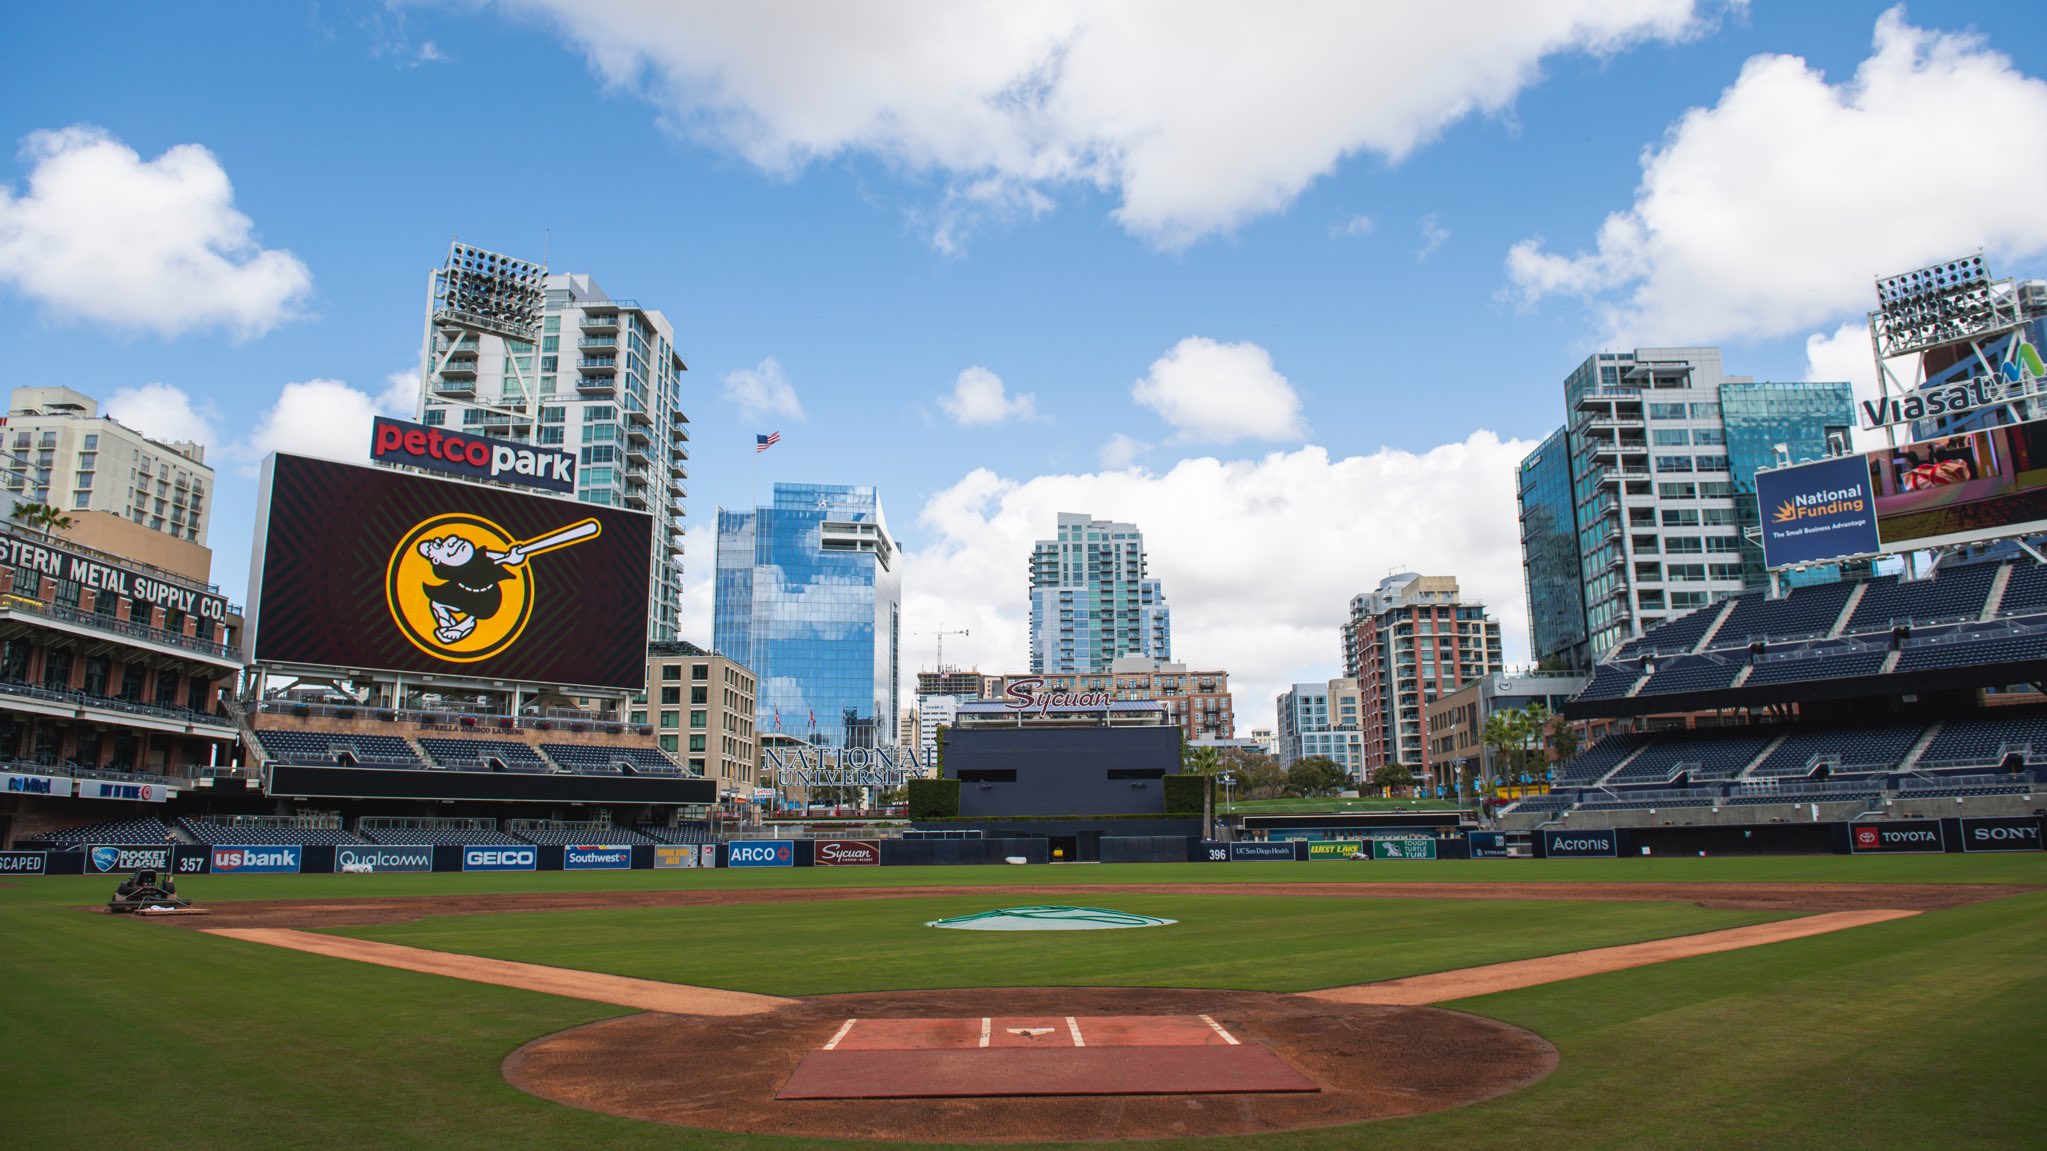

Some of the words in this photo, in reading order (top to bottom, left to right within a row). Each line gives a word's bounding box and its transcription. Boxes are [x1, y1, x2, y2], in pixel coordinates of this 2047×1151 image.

[1863, 376, 1991, 427] Viasat
[1795, 484, 1862, 507] National
[1797, 499, 1864, 519] Funding
[1786, 528, 1803, 536] Small
[1804, 525, 1831, 534] Business
[1832, 520, 1866, 530] Advantage
[70, 558, 129, 596] METAL
[134, 577, 197, 613] SUPPLY
[201, 597, 225, 622] CO.
[1004, 677, 1114, 718] Sycuan
[492, 727, 524, 735] LANDING
[762, 746, 937, 770] NATIONAL
[777, 769, 925, 786] UNIVERSITY
[23, 778, 51, 794] Mitel
[1882, 831, 1936, 842] TOYOTA
[1974, 827, 2038, 840] SONY
[1336, 845, 1359, 853] LAKE
[1553, 837, 1609, 850] Acronis
[120, 850, 166, 859] ROCKET
[466, 851, 534, 865] GEICO
[569, 852, 619, 863] Southwest
[657, 849, 673, 857] HOME
[674, 849, 690, 857] RUN
[731, 847, 774, 861] ARCO
[822, 843, 871, 862] Sycuan
[1209, 849, 1226, 860] 396
[1256, 847, 1271, 855] Diego
[119, 859, 166, 868] LEAGUE
[180, 857, 204, 872] 357
[340, 850, 429, 867] Qualcomm
[665, 857, 681, 865] JACK
